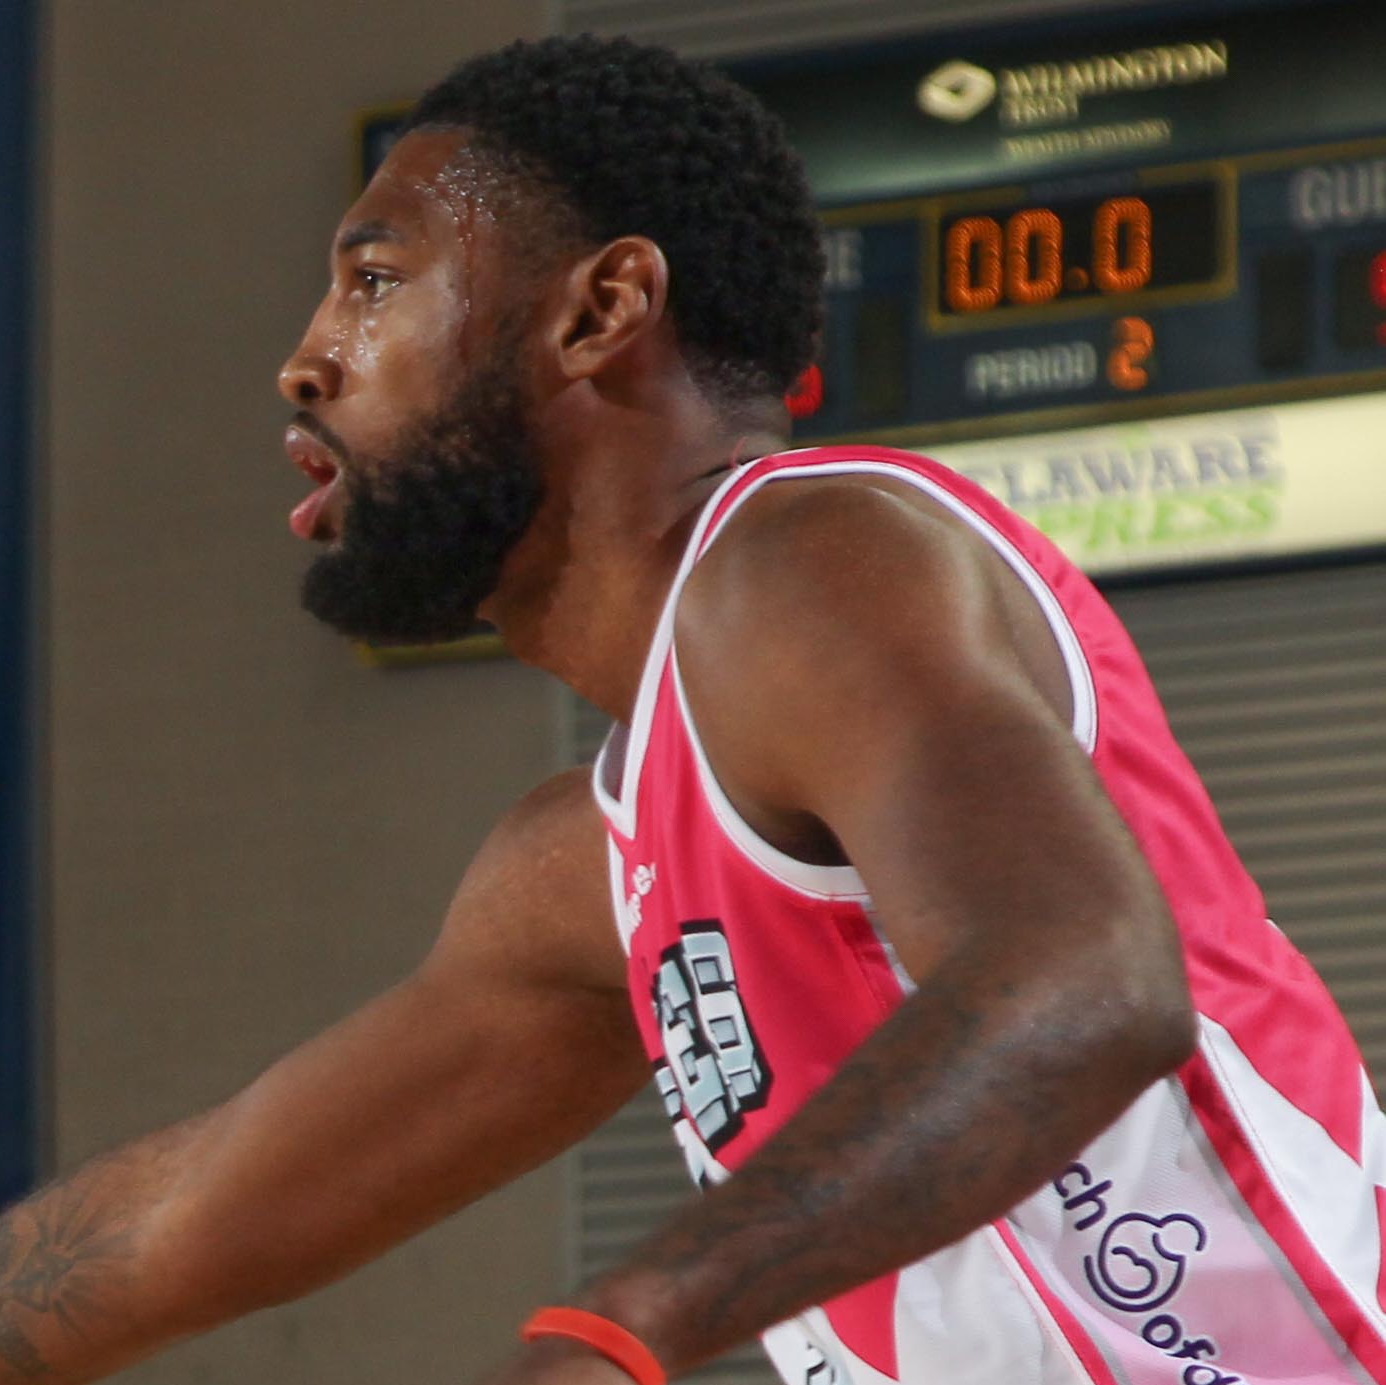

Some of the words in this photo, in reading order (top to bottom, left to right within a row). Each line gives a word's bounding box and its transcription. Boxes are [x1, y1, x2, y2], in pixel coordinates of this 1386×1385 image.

[945, 197, 1152, 313] 00.0
[966, 340, 1098, 395] PERIOD
[1106, 315, 1154, 391] 2
